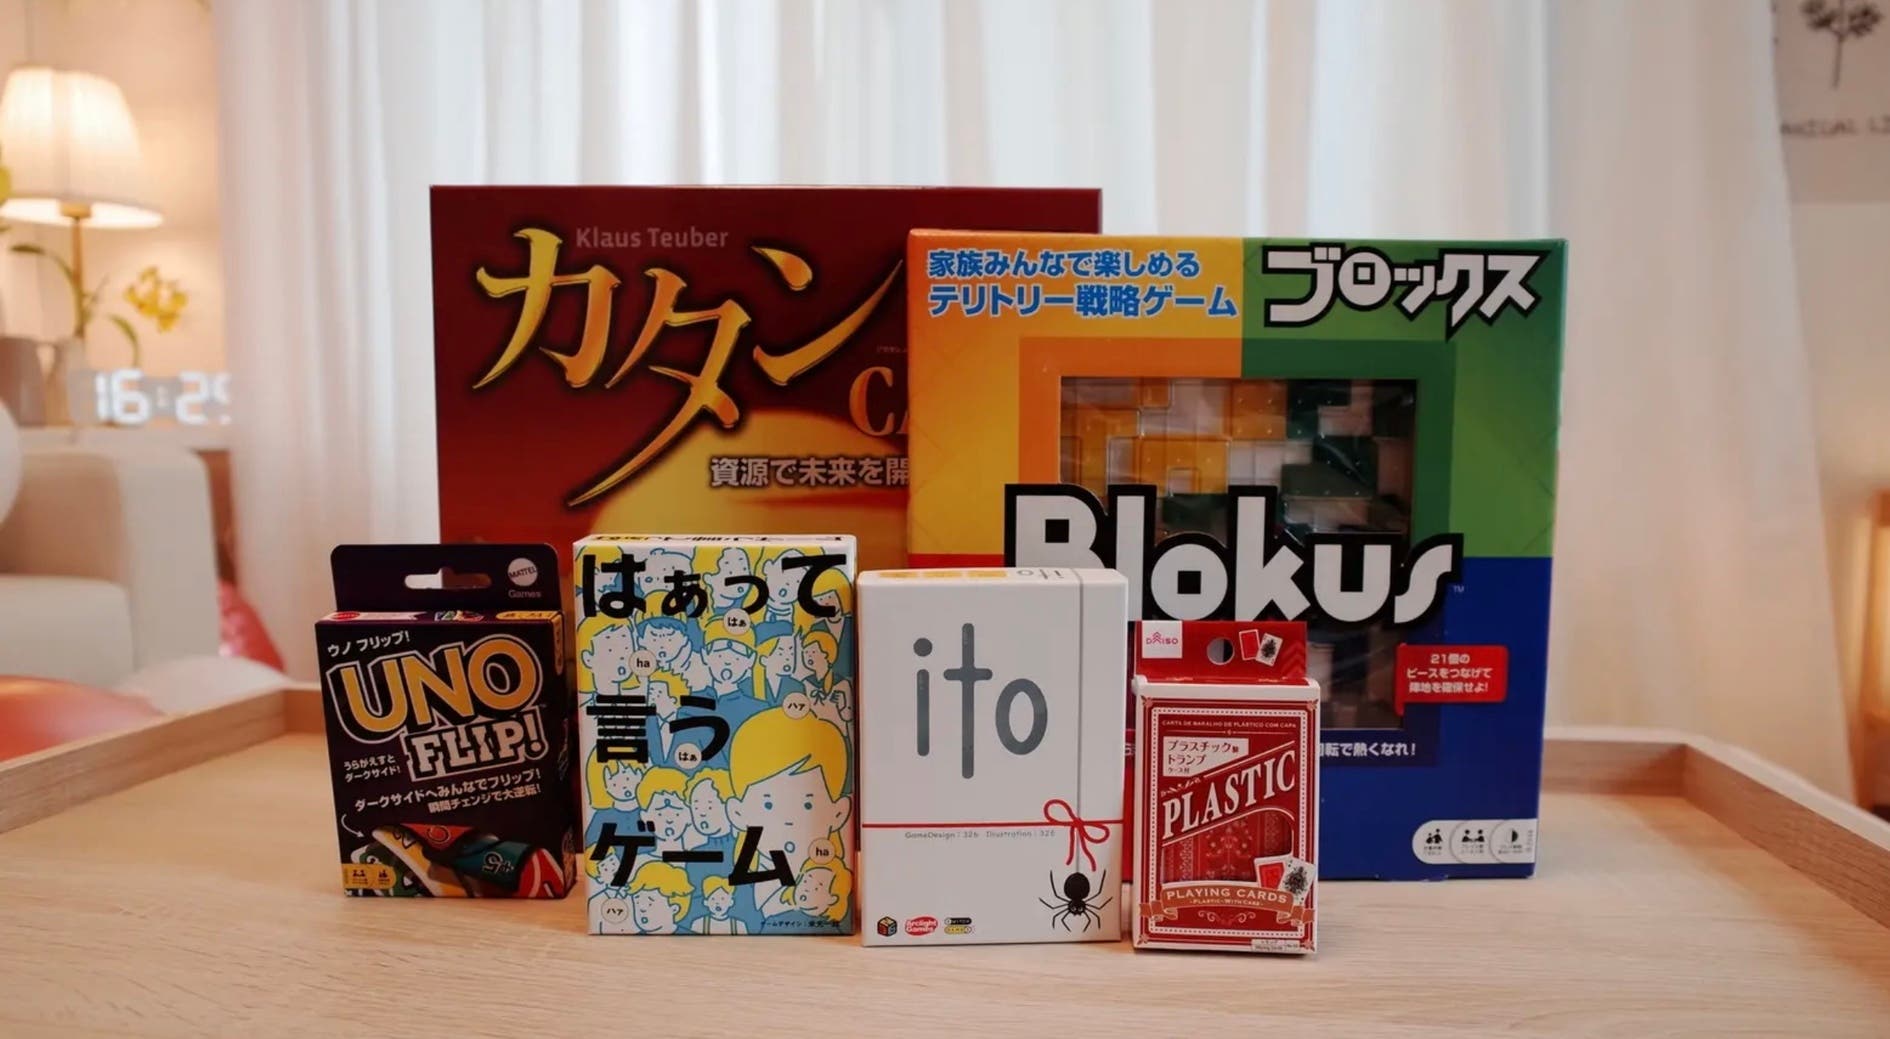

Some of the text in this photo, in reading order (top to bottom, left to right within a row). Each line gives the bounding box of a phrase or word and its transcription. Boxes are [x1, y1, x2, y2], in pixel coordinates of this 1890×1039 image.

[576, 227, 728, 248] Klaus Teuber
[927, 250, 1201, 280] 家族みんなで楽しめる
[927, 284, 1239, 318] テリトリー戦略ゲーム
[1265, 244, 1547, 336] ブロックス
[471, 227, 904, 507] カタン
[848, 366, 908, 438] C
[1010, 489, 1458, 622] Blokus
[508, 565, 538, 579] MATTEL
[508, 589, 542, 599] Games
[582, 553, 848, 619] はぁって
[726, 616, 748, 628] はぁ
[327, 630, 411, 658] ウノ フリップ!
[1146, 632, 1179, 645] DAISO
[636, 657, 651, 668] ha
[1429, 653, 1471, 665] 21個の
[1406, 667, 1494, 680] ピースをつなげて
[330, 634, 542, 741] UNO
[1408, 681, 1489, 695] 陣地を確保せよ!
[913, 622, 1048, 779] ito
[586, 694, 731, 763] 言う
[405, 709, 548, 779] FLIP!
[343, 753, 396, 771] うらがえすと
[677, 751, 699, 762] はぁ
[1167, 754, 1208, 766] トランプ
[344, 765, 401, 783] ダークサイド!
[354, 768, 543, 812] ダークサイドへみんなでフリップ!
[1162, 751, 1296, 840] PLASTIC
[589, 820, 796, 887] ゲーム
[814, 846, 830, 858] ha
[1166, 887, 1288, 905] PLAYING CARDS
